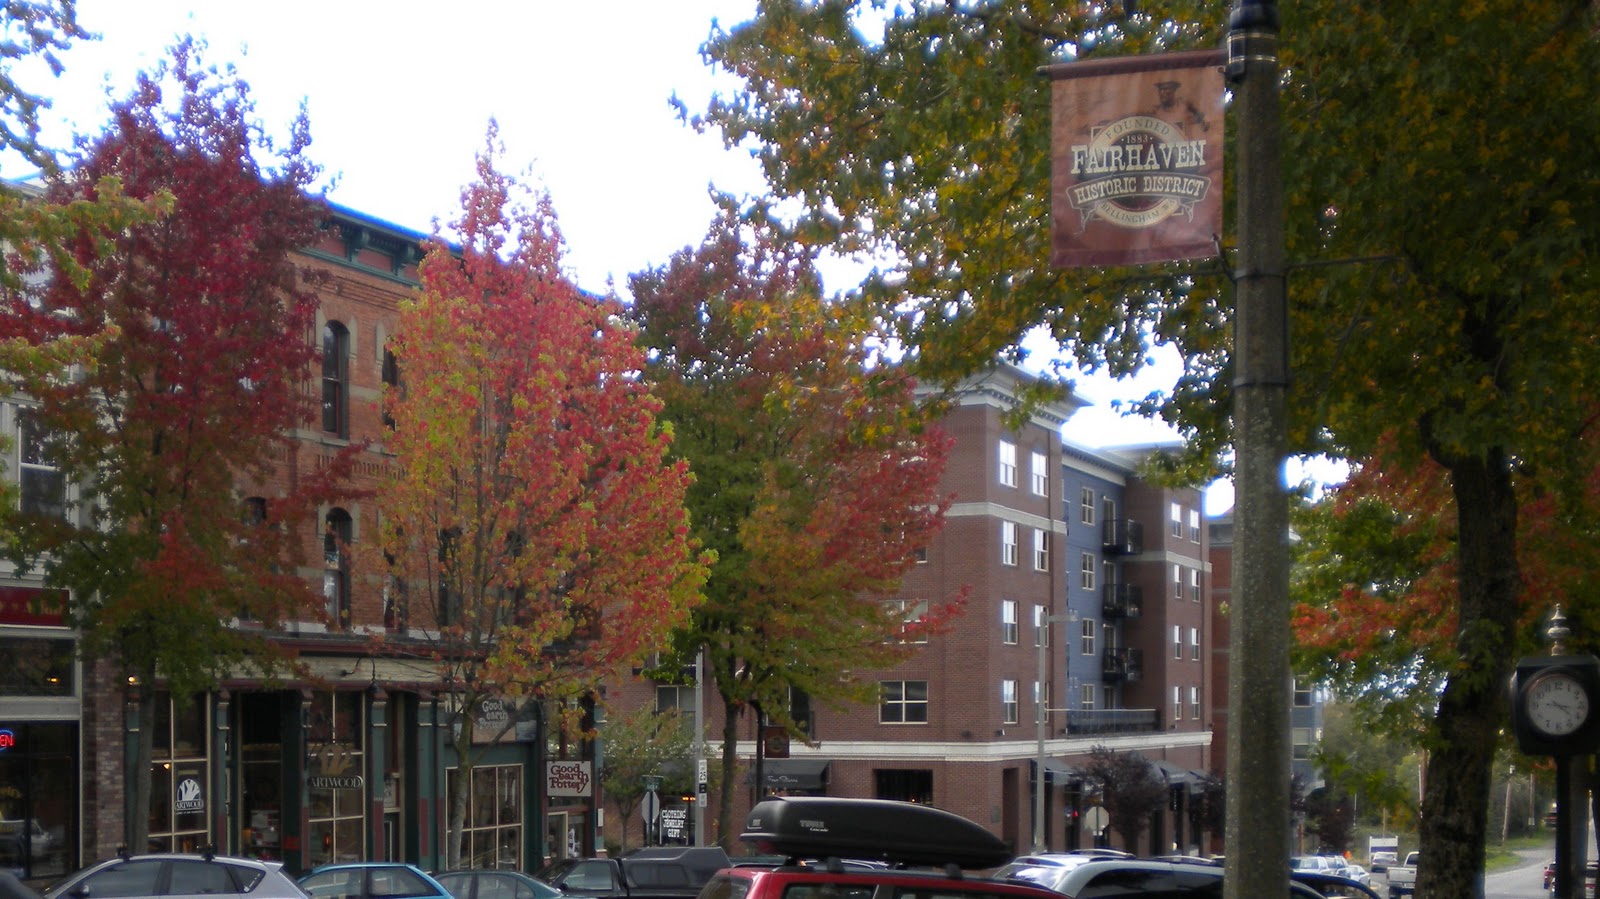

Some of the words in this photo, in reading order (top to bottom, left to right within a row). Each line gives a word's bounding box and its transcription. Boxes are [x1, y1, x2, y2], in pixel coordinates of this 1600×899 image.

[1105, 118, 1170, 139] FOUNDED
[1126, 134, 1149, 144] 1883
[1070, 139, 1207, 174] FAIRHAVEN
[1074, 177, 1137, 204] HISTORIC
[1143, 176, 1204, 197] DISTRICT
[482, 700, 503, 712] Good
[550, 763, 580, 775] Good
[309, 776, 361, 788] ARTWOOD
[559, 771, 589, 784] earth
[548, 777, 588, 794] Pottery
[176, 800, 204, 809] ARTWOOD
[661, 809, 687, 819] CLOTHING
[667, 828, 681, 838] GIFT
